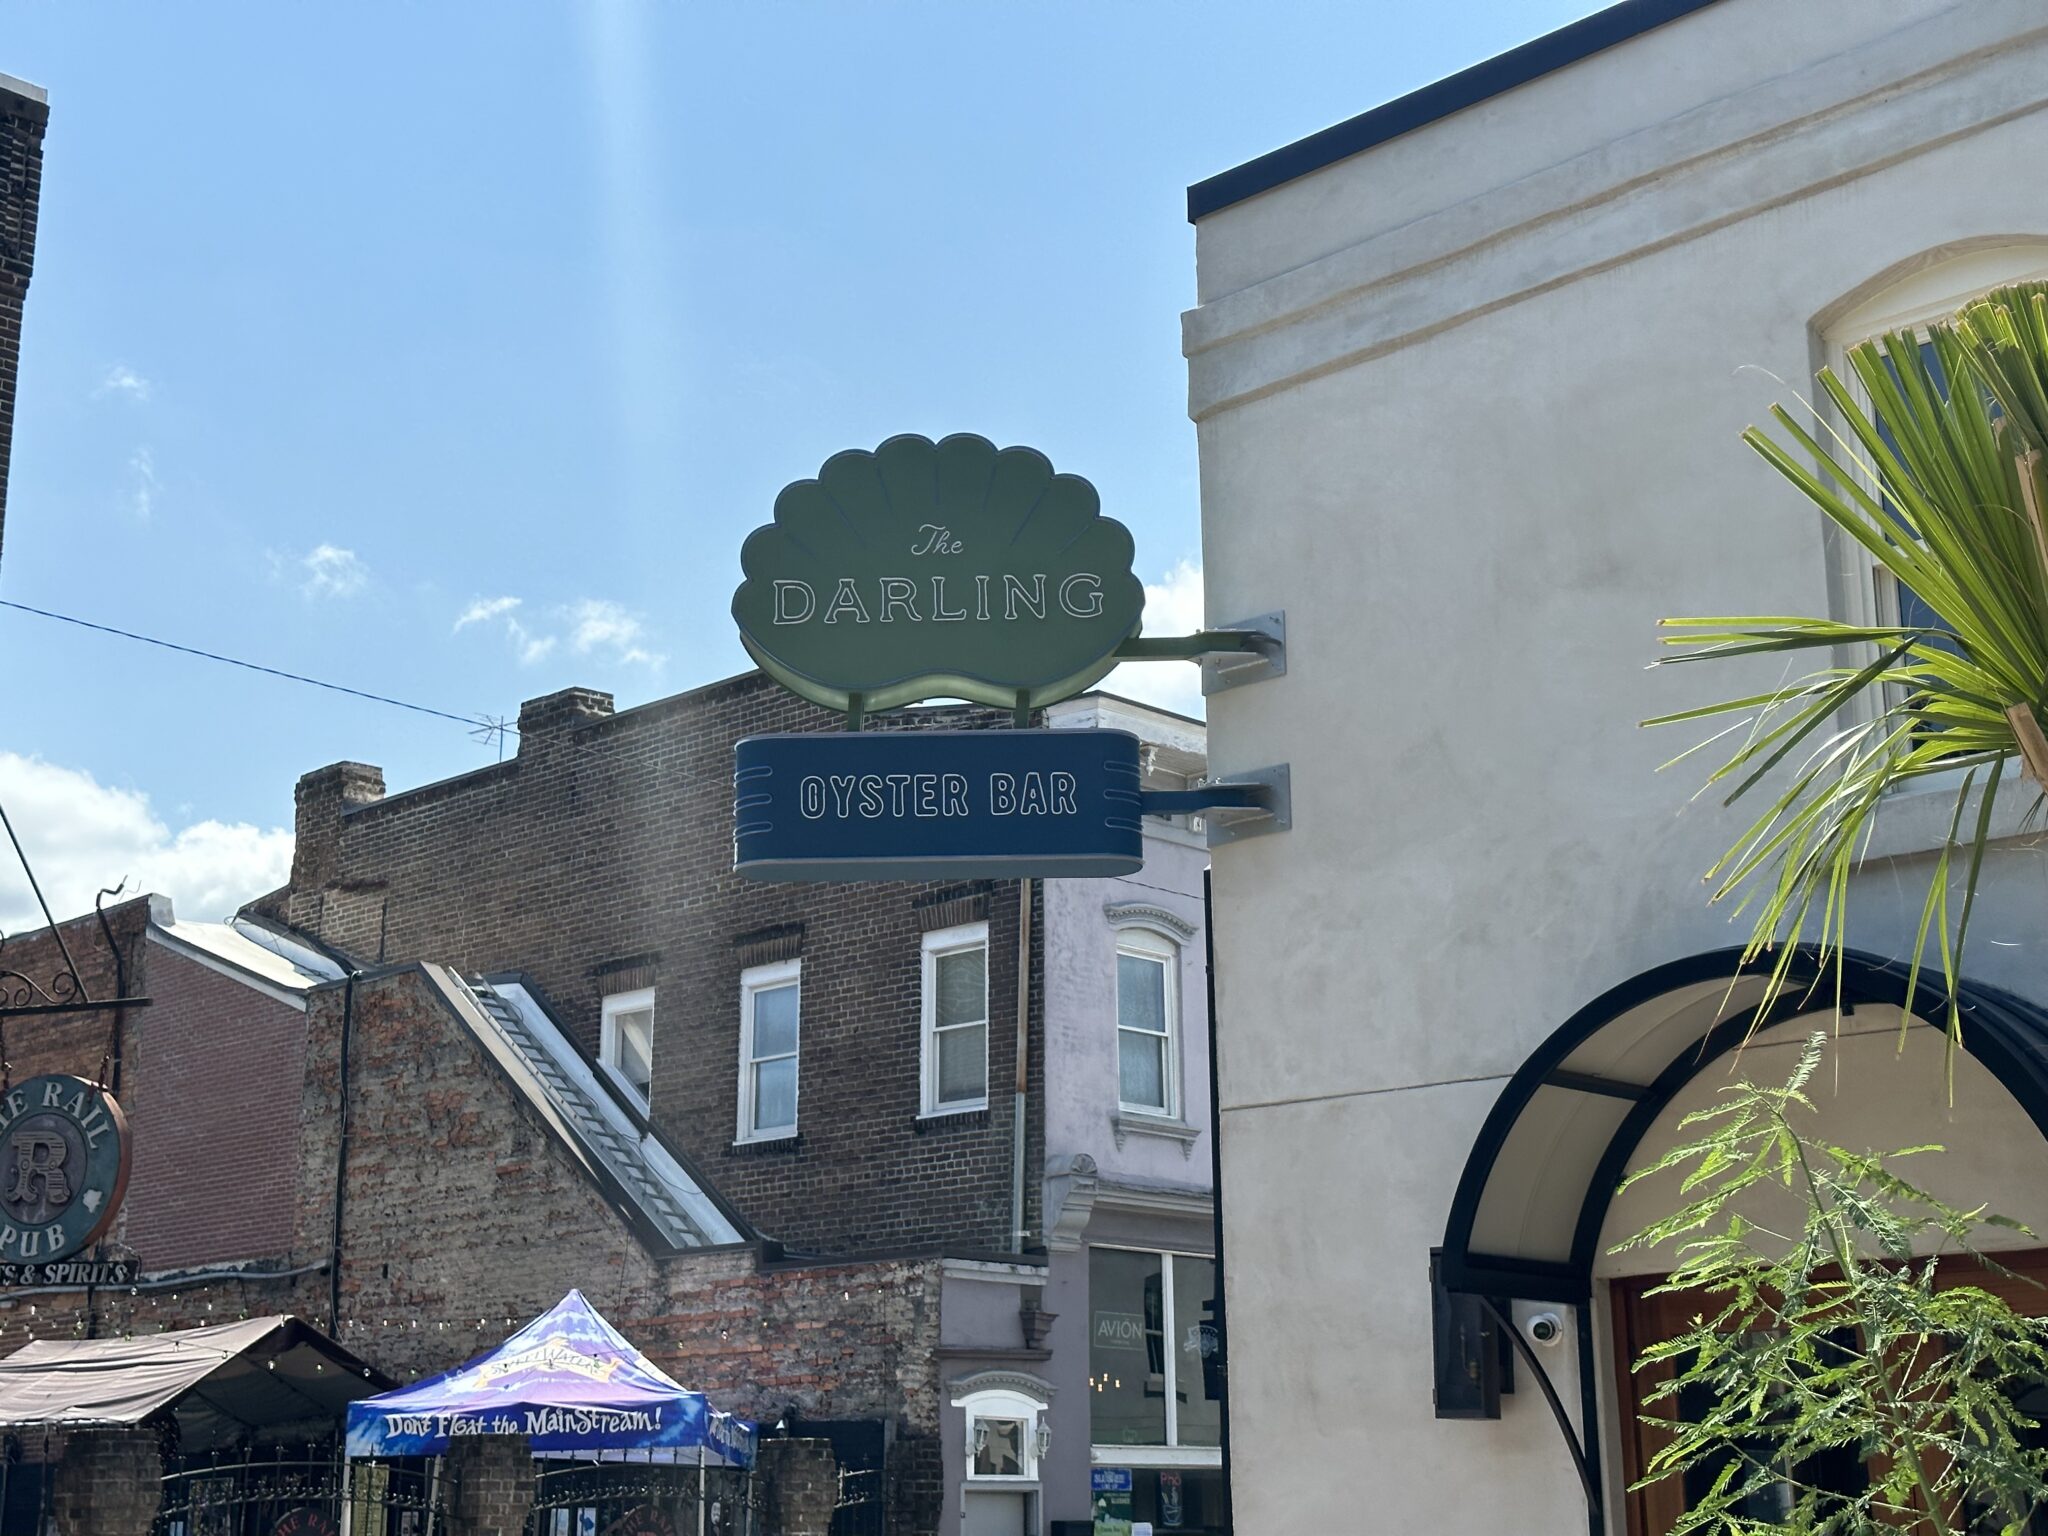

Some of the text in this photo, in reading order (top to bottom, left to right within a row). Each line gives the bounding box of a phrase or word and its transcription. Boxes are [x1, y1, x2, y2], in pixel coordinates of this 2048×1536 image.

[911, 524, 964, 556] The
[773, 573, 1104, 625] DARLING
[800, 771, 1077, 819] OYSTER BAR
[41, 1081, 110, 1149] RAIL
[5, 1131, 71, 1203] R
[0, 1223, 65, 1257] PUB
[19, 1264, 36, 1284] &
[43, 1263, 128, 1285] SPIRITS
[434, 1412, 487, 1438] Float
[491, 1414, 518, 1435] the
